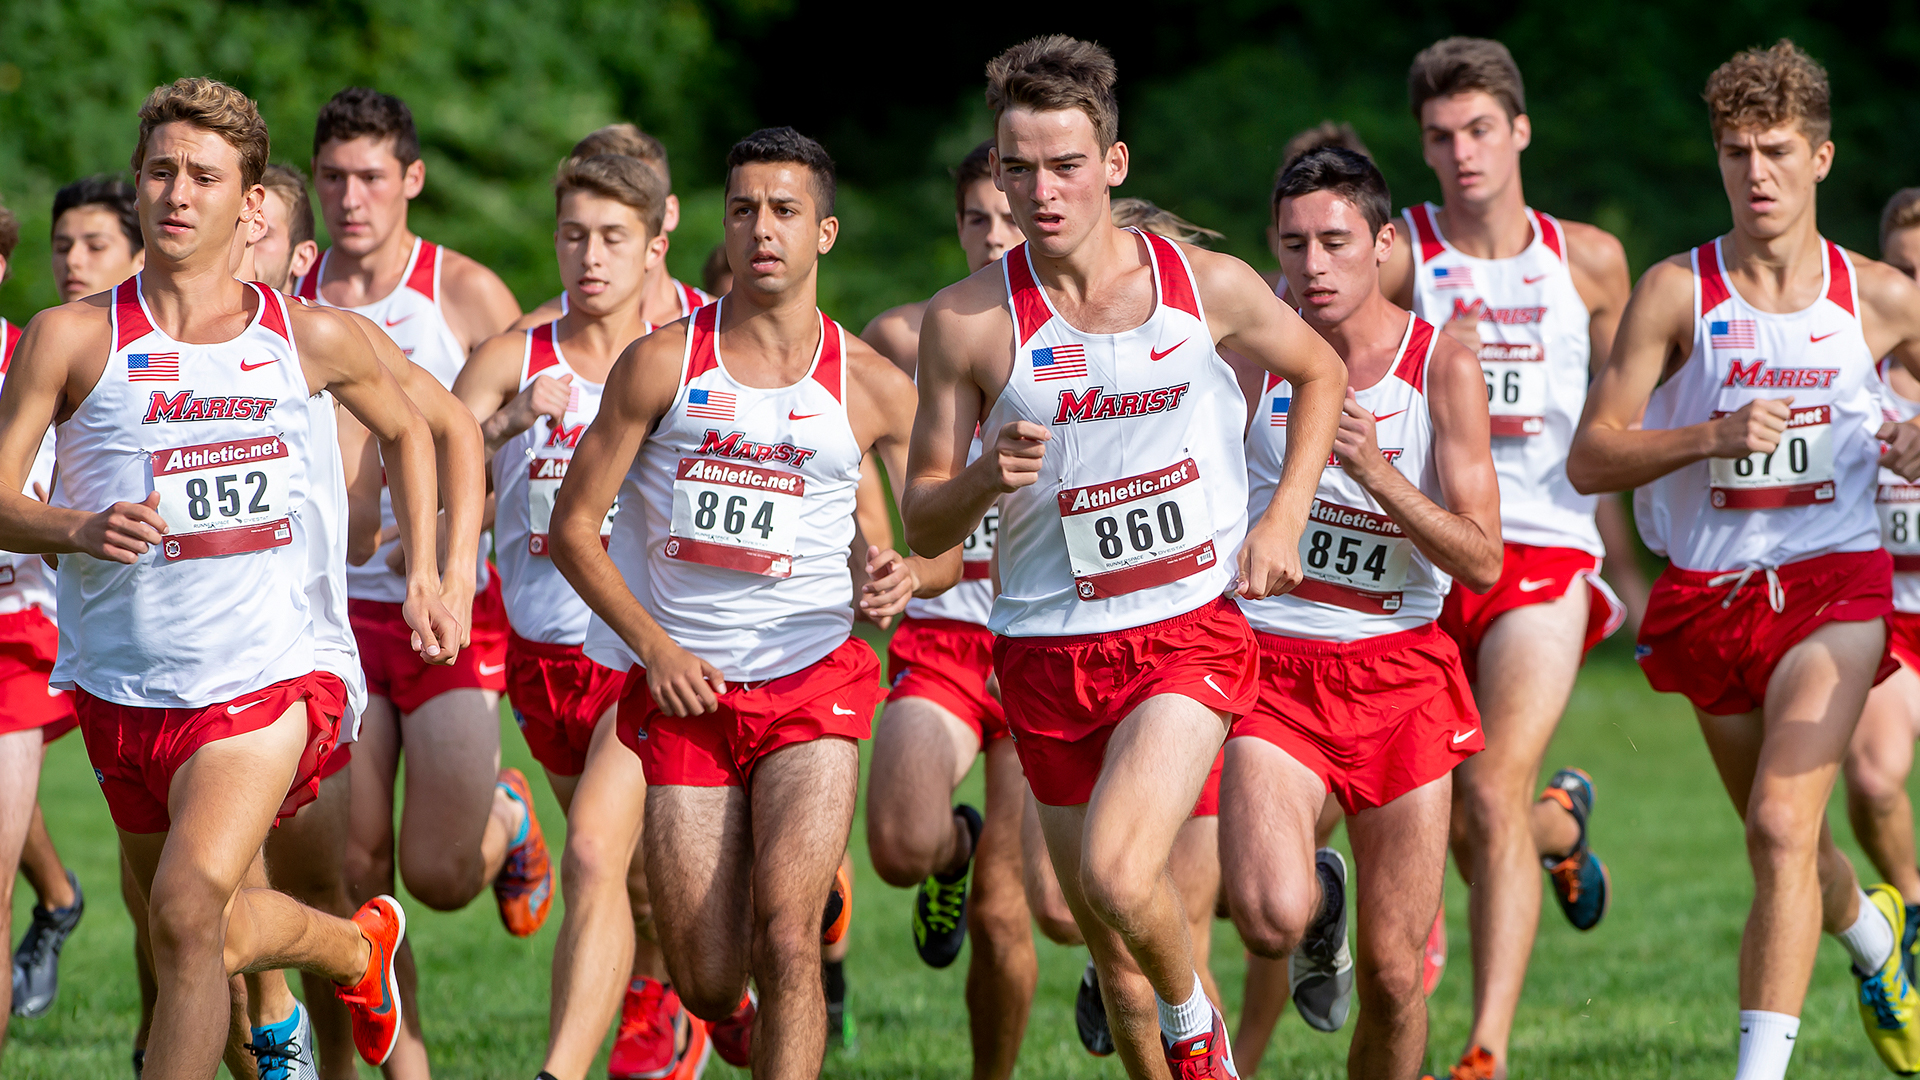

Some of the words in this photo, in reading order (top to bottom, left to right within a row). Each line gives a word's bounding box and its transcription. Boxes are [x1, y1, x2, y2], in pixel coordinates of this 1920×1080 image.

[1722, 357, 1841, 389] MARIST
[141, 390, 277, 424] MARIST
[1052, 381, 1191, 426] MARIST
[163, 438, 280, 472] Athletic.net
[684, 460, 798, 492] Athletic.net
[185, 470, 270, 521] 852
[1070, 463, 1190, 512] Athletic.net
[694, 490, 775, 540] 864
[1094, 500, 1185, 559] 860
[1307, 499, 1402, 535] Athletic.ne
[1307, 529, 1389, 582] 854
